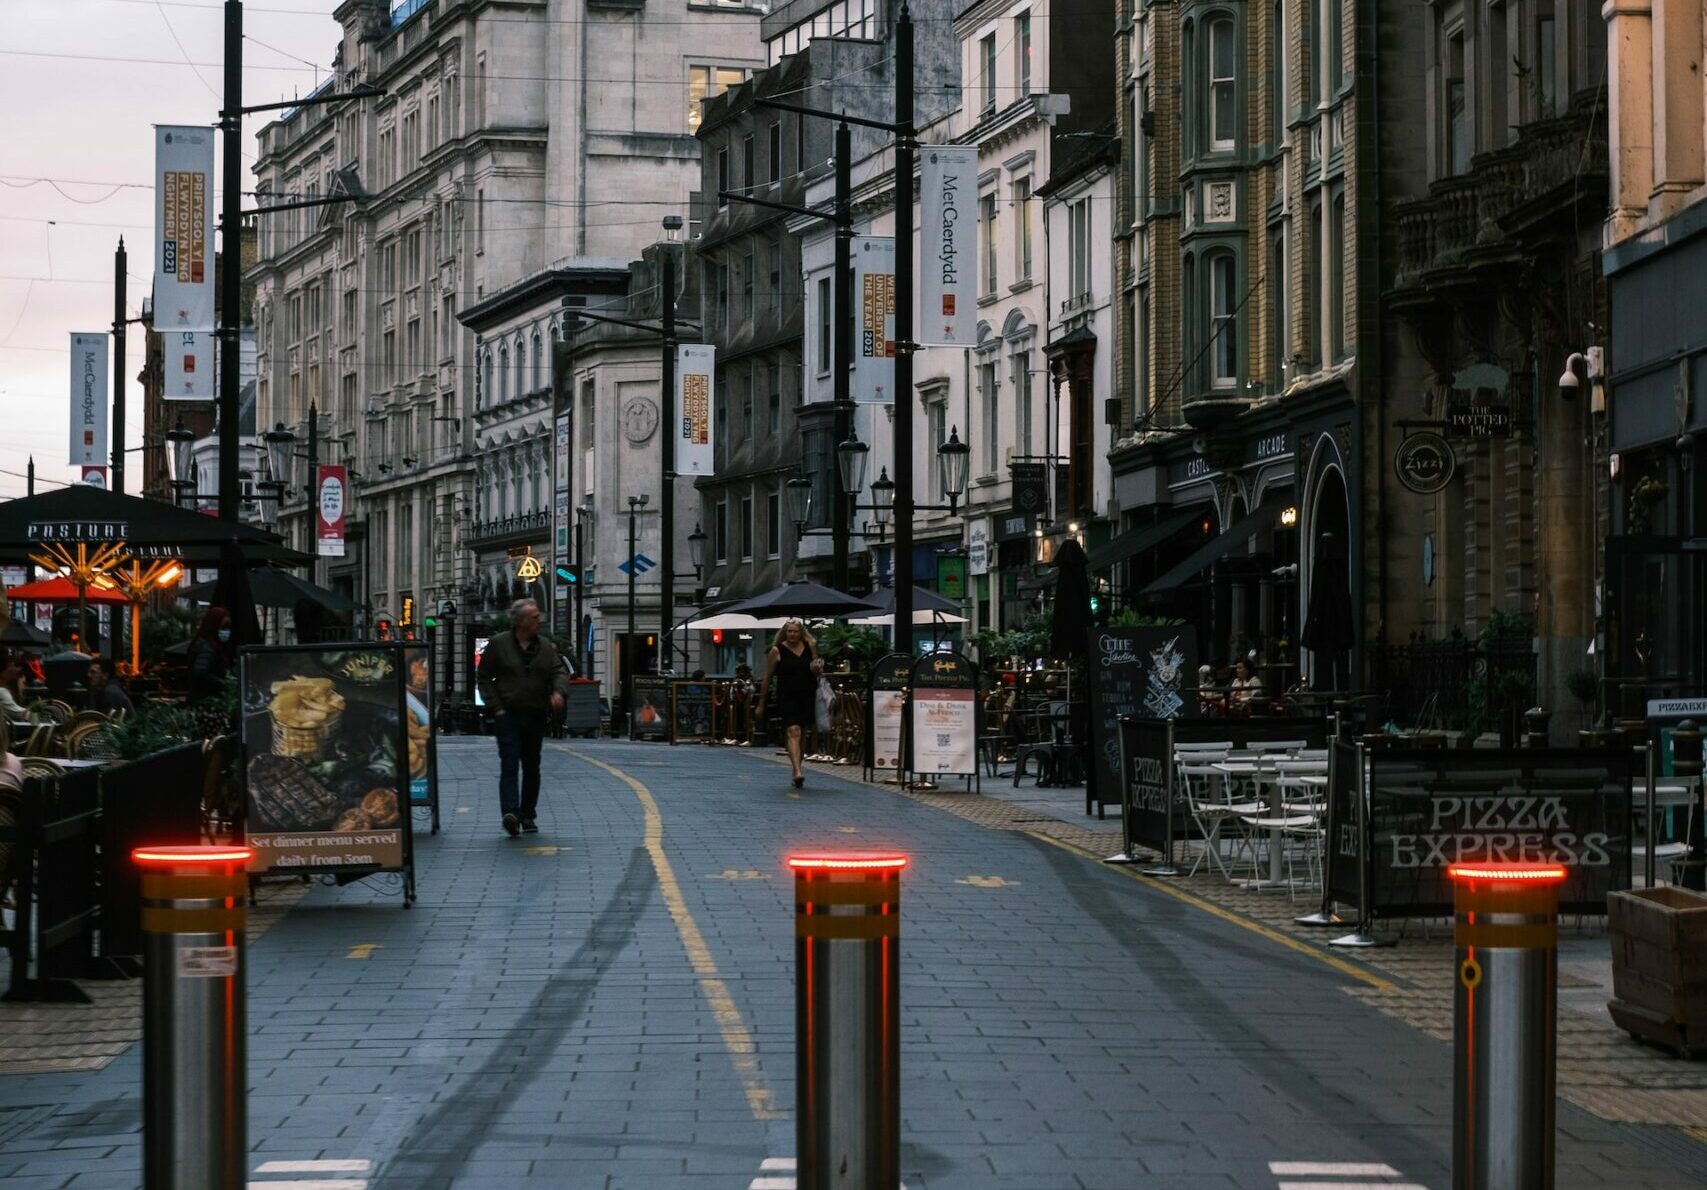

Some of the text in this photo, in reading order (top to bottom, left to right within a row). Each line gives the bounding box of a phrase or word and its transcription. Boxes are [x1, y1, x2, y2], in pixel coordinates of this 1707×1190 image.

[165, 173, 176, 273] NGHYMRU 2021
[179, 174, 189, 280] FLWYDDYN YNG
[193, 174, 203, 259] PRIFYSGOL Y
[939, 174, 958, 285] MetCaerdydd
[886, 275, 895, 314] WELSH
[864, 275, 873, 357] THE YEAR 2021
[875, 275, 885, 356] UNIVERSITY OF
[81, 351, 96, 425] MetCaerdydd
[1452, 414, 1508, 426] POTTED
[1470, 425, 1492, 437] PIG
[1257, 434, 1286, 458] ARCADE
[27, 523, 128, 538] PASTURE
[340, 655, 394, 679] JUNIPER
[1430, 796, 1570, 831] PIZZA
[251, 831, 397, 848] Set dinner menu served
[1391, 832, 1610, 868] EXPRESS
[310, 854, 342, 866] from
